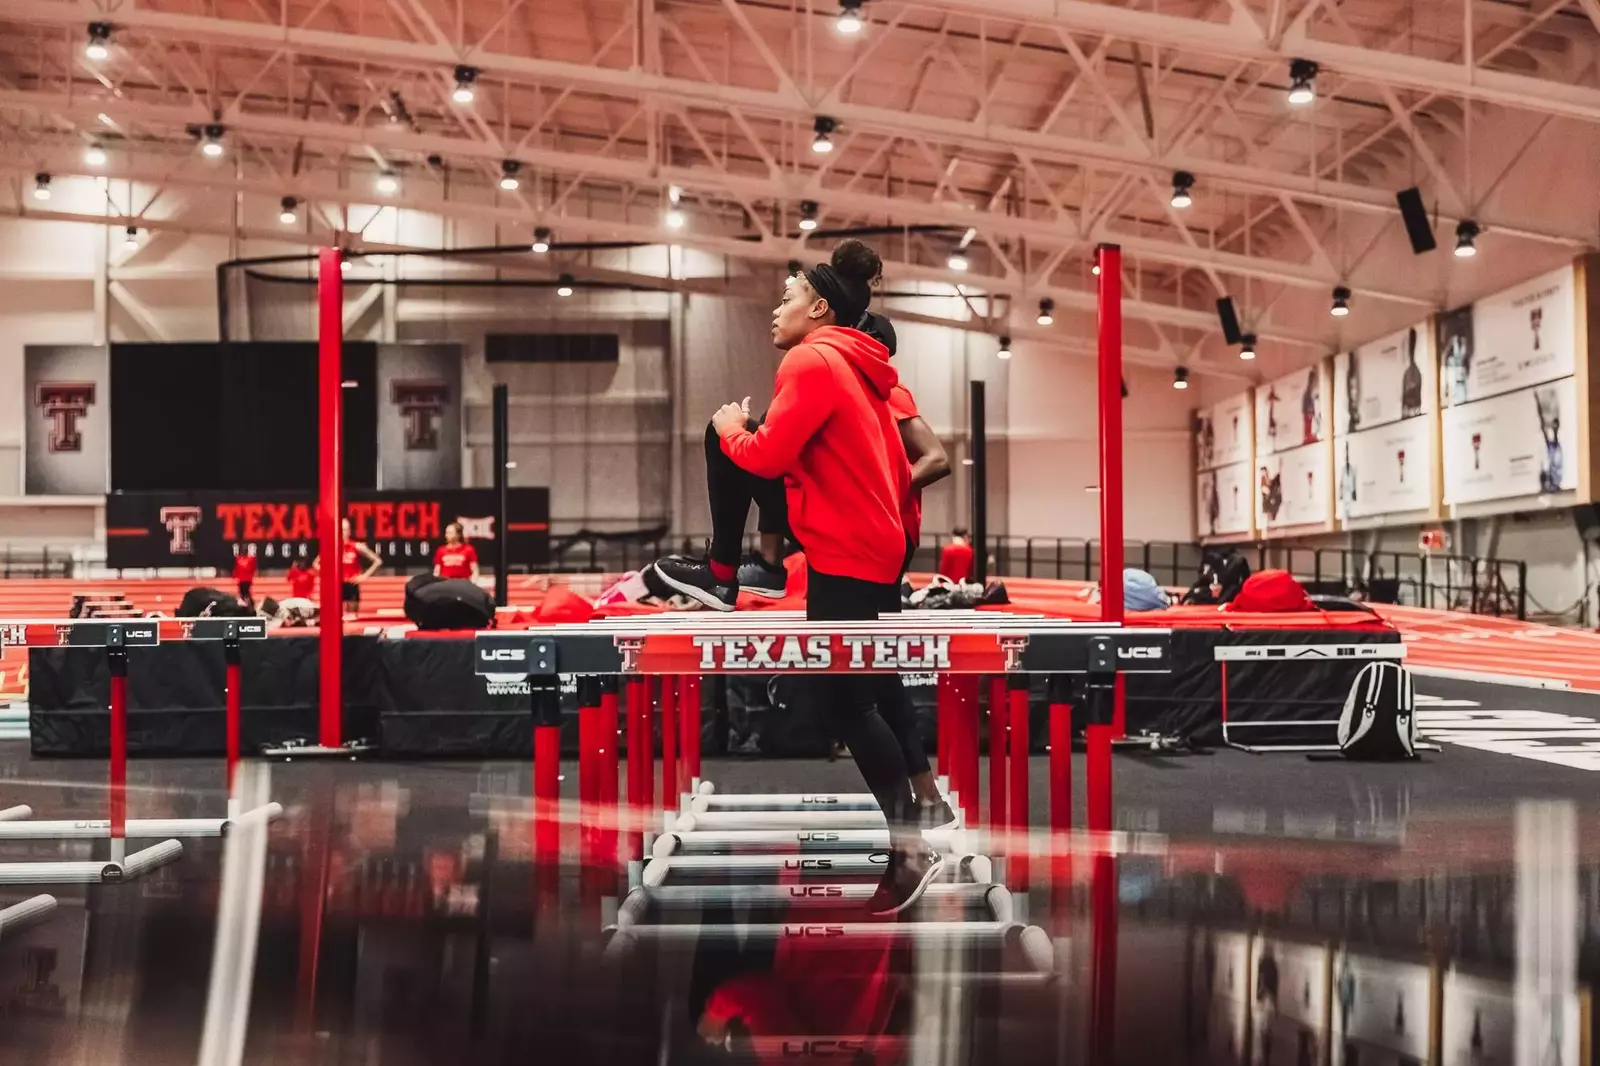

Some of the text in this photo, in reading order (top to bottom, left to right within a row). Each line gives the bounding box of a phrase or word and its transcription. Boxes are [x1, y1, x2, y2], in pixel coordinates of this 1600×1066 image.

[216, 503, 320, 540] TEXA
[347, 502, 440, 538] TECH
[374, 541, 430, 556] IELD
[126, 630, 152, 638] UCS
[239, 625, 262, 633] UCS
[481, 649, 526, 661] UCS
[692, 635, 832, 669] TEXAS
[842, 635, 951, 668] TECH
[1117, 646, 1163, 658] UCS
[801, 796, 838, 804] UCS
[796, 832, 840, 841] UCS
[784, 859, 833, 870] UCS
[790, 886, 843, 897] UCS
[784, 926, 845, 937] UCS
